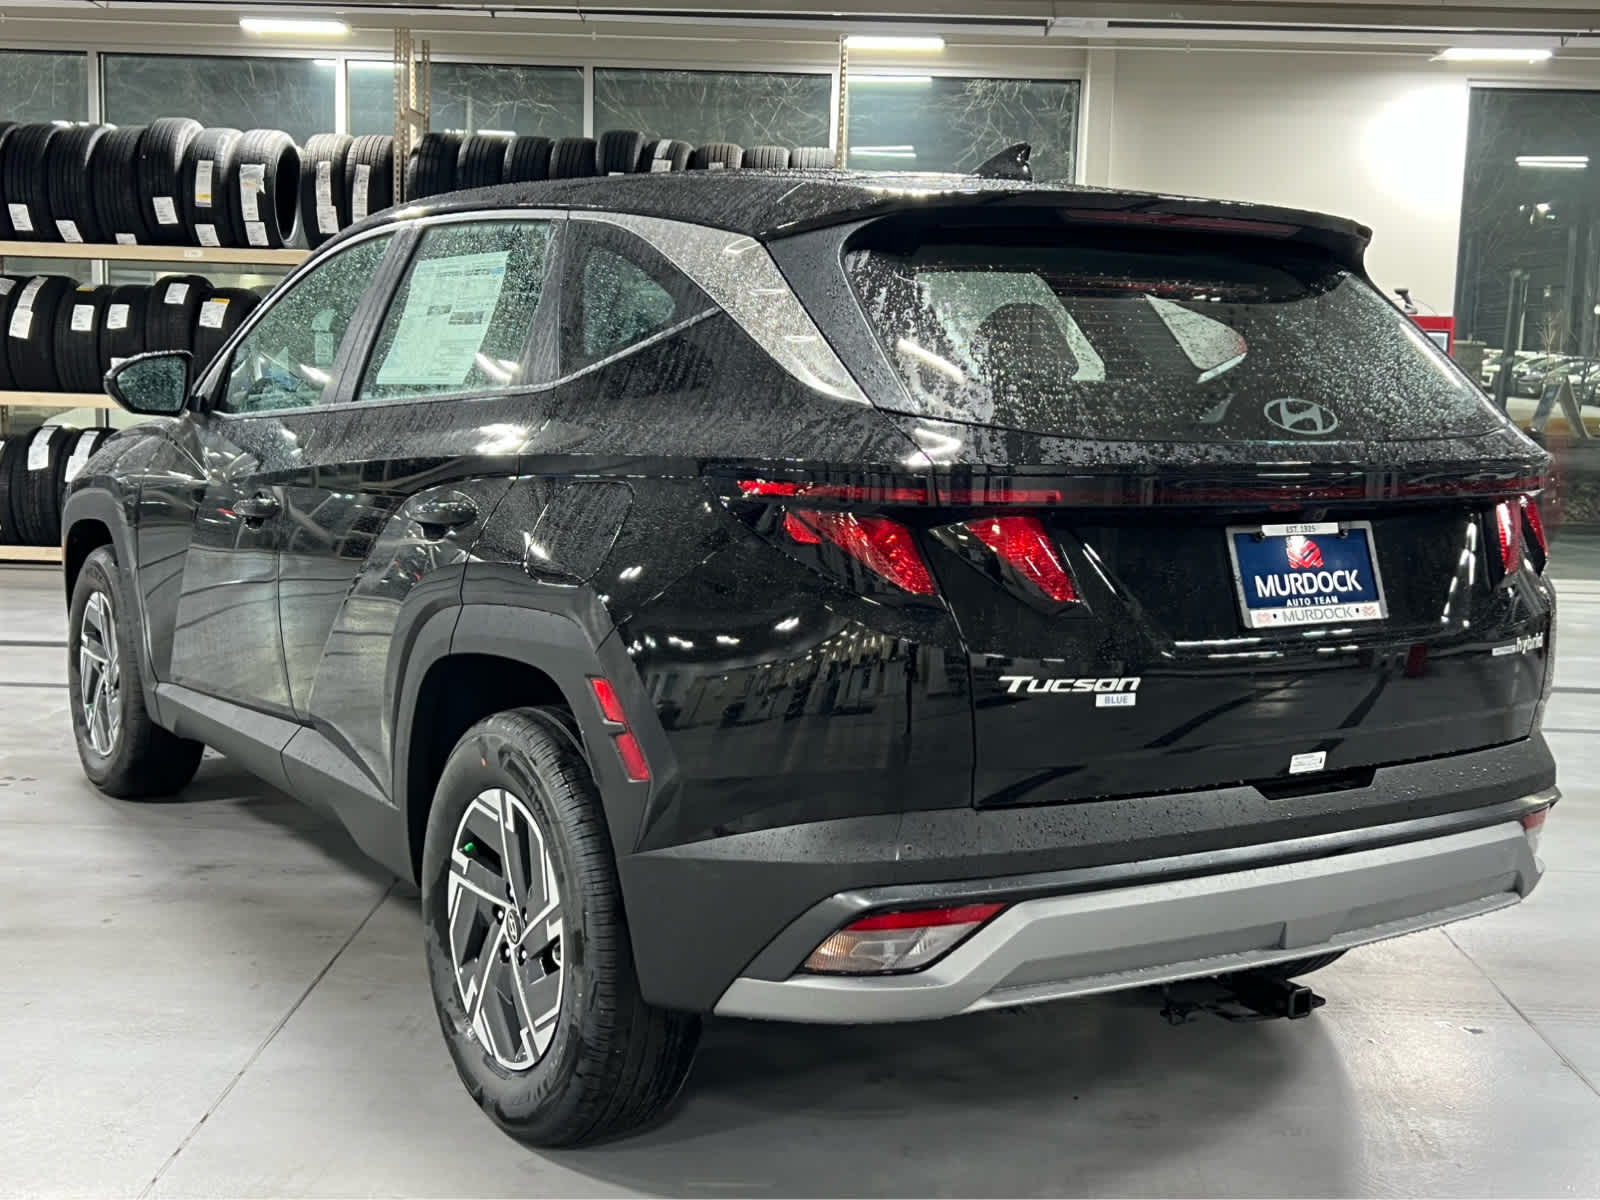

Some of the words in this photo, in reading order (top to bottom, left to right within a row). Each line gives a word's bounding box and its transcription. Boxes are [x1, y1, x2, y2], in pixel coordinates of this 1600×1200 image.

[1254, 569, 1363, 598] MURDOCK
[1286, 597, 1311, 608] AUTO
[1313, 595, 1339, 606] TEAM
[1282, 606, 1354, 623] MURDOCK
[1104, 695, 1129, 705] BLUE
